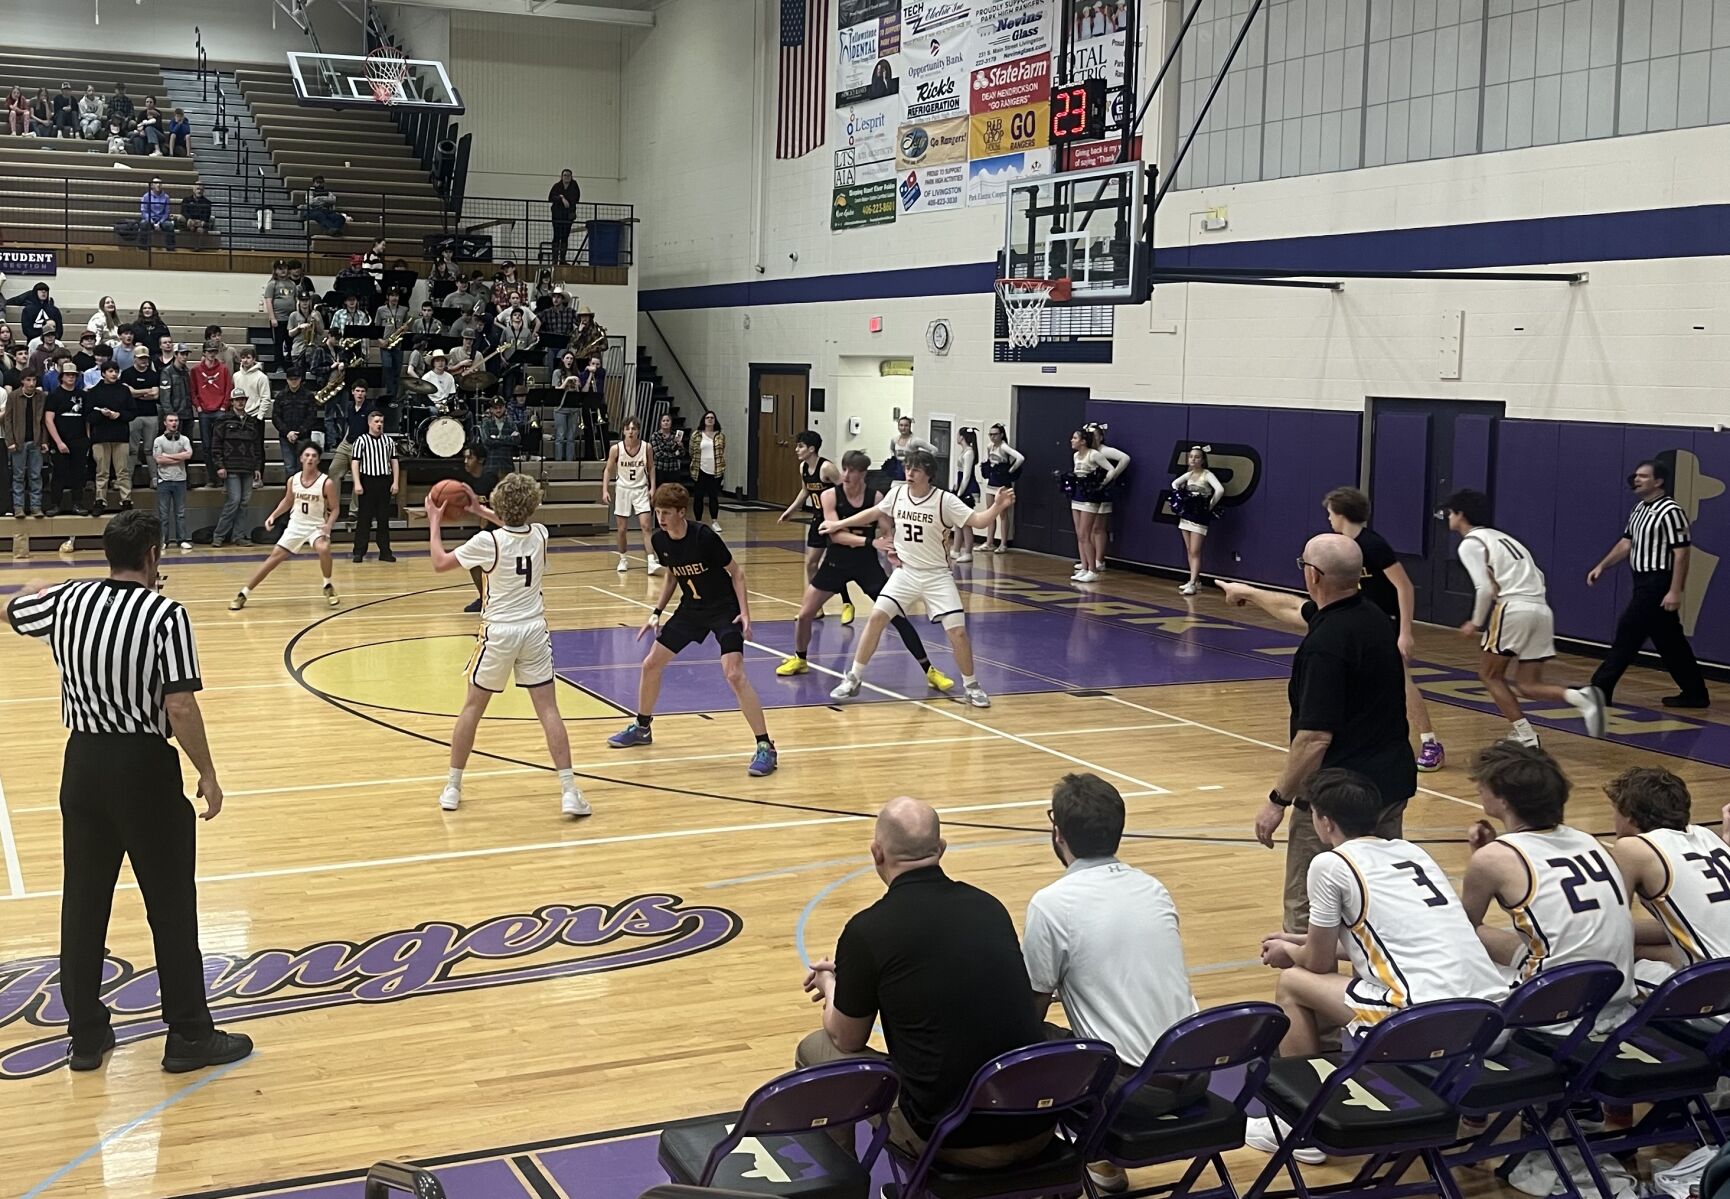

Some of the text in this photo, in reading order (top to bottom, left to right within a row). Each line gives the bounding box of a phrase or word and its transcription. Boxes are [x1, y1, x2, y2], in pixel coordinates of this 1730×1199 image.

[904, 2, 924, 18] TECH
[976, 3, 1003, 17] PROUDLY
[981, 14, 996, 23] PARK
[996, 11, 1043, 32] Nevins
[1012, 27, 1039, 41] Glass
[851, 40, 877, 60] DENTAL
[909, 59, 946, 78] Opportunity
[946, 52, 963, 66] Bank
[917, 76, 955, 103] Rick's
[996, 83, 1038, 99] HENDRICKSON
[908, 98, 960, 117] REFRIGERATION
[1054, 89, 1087, 137] 23
[855, 113, 886, 132] L'esprit
[1010, 110, 1037, 141] GO
[930, 137, 939, 148] Go
[940, 133, 968, 147] Rangers!
[1010, 139, 1036, 151] RANGERS
[836, 150, 855, 168] LTS
[836, 169, 855, 187] AIA
[924, 187, 962, 198] OF LIVINGSTON
[3, 262, 47, 270] SECTION
[86, 253, 95, 265] D
[629, 469, 636, 481] 2
[302, 502, 309, 515] 0
[897, 509, 934, 525] RANGERS
[902, 525, 924, 543] 32
[1498, 538, 1524, 561] 11
[516, 555, 533, 588] 4
[687, 579, 702, 600] 1
[1391, 860, 1449, 908] 3
[1547, 849, 1624, 915] 24
